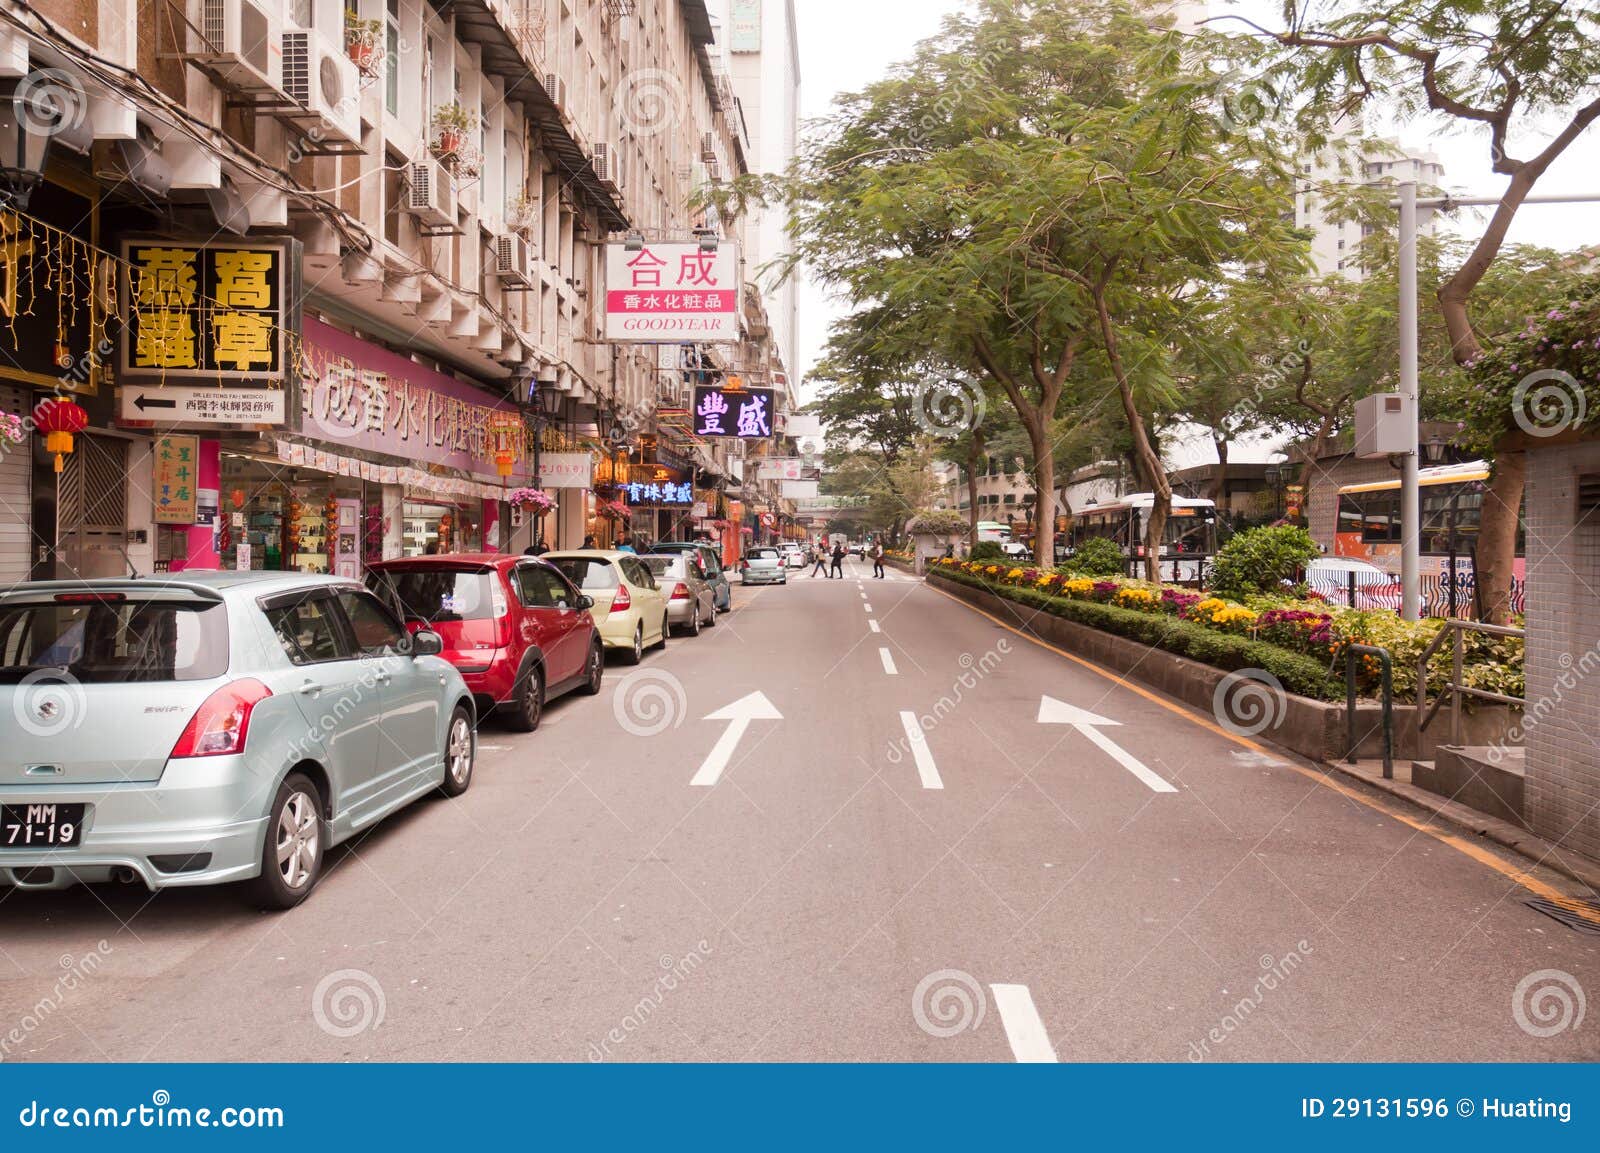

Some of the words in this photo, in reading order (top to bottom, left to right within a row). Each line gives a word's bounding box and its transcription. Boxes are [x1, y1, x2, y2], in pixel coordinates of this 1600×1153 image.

[626, 248, 719, 288] 合成
[624, 294, 721, 309] 香水化粧品
[624, 318, 721, 331] GOODYEAR
[26, 804, 57, 824] MM
[6, 823, 75, 845] 71-19
